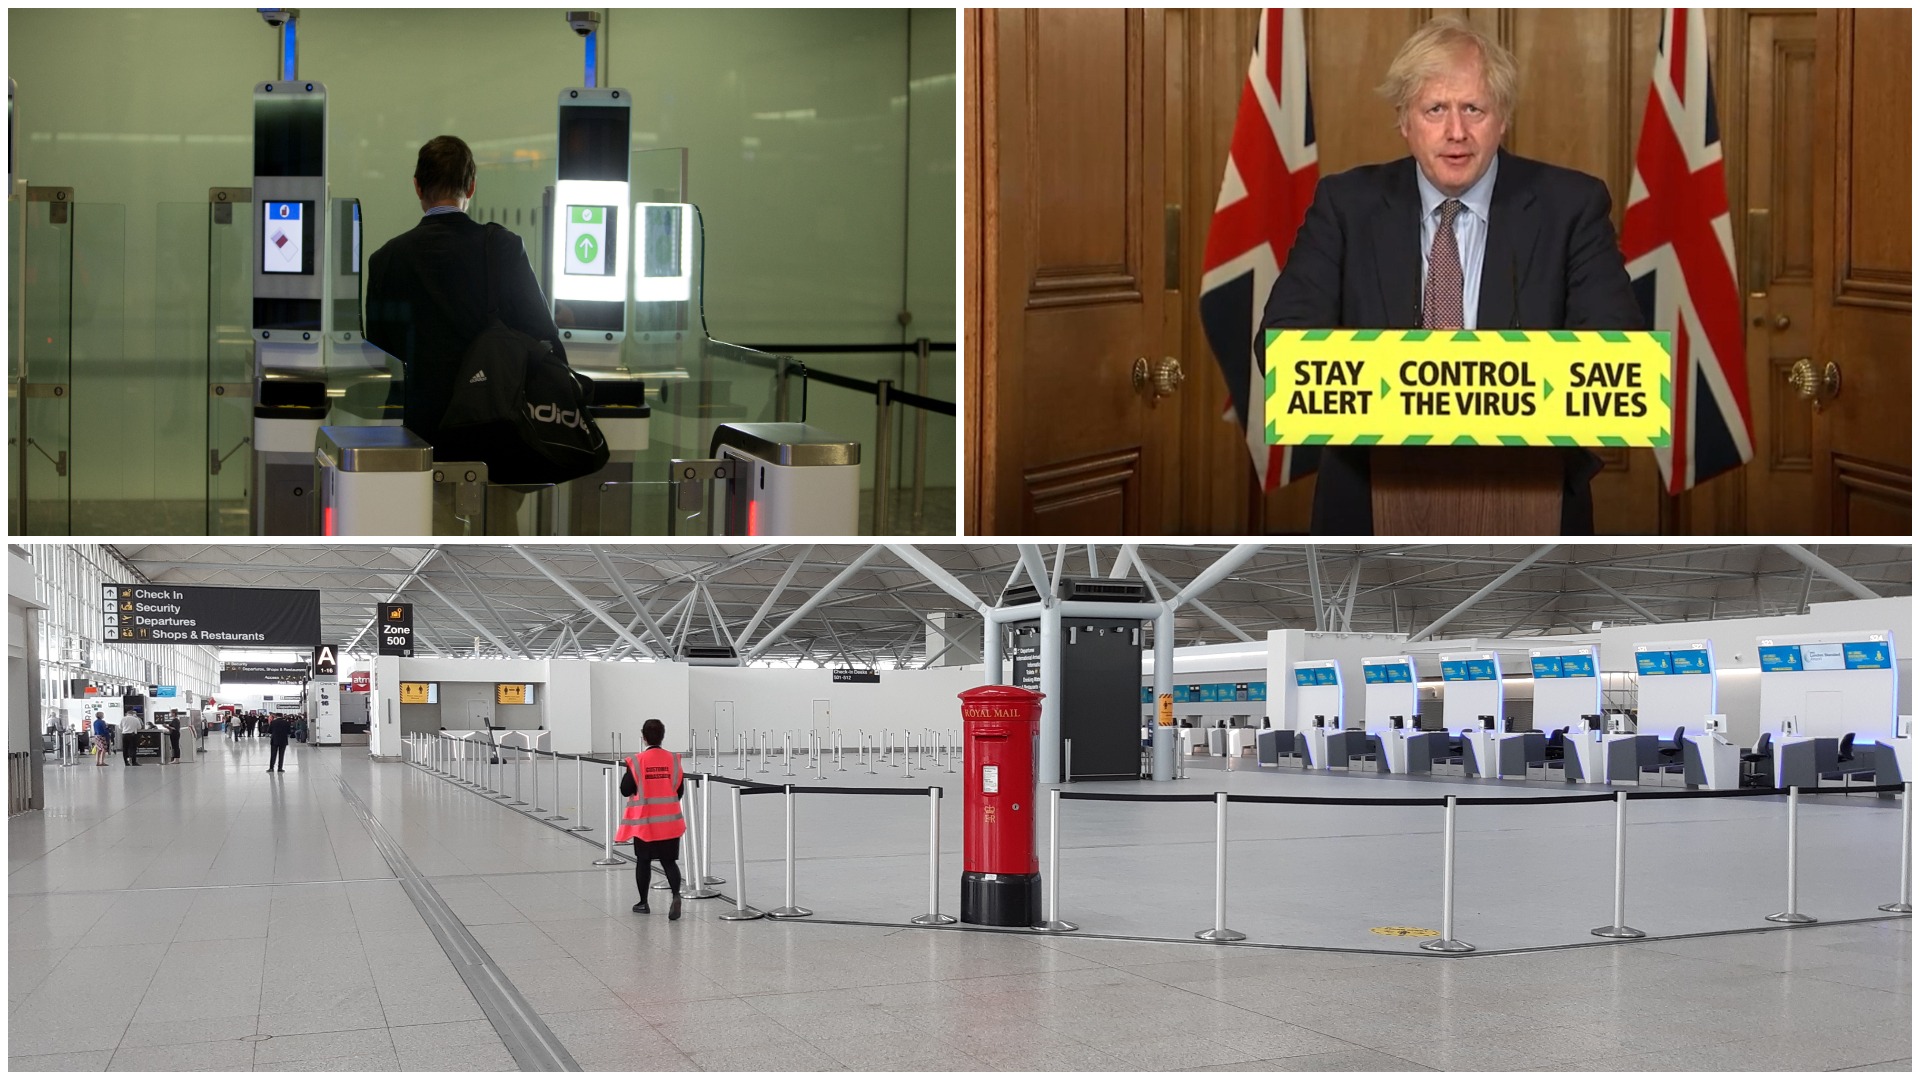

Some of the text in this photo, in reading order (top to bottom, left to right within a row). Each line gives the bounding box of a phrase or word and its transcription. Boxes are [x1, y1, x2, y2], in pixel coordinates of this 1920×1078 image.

[1295, 360, 1365, 386] STAY
[1400, 361, 1536, 387] CONTROL
[1570, 362, 1642, 388] SAVE
[1287, 390, 1373, 415] ALERT
[1400, 392, 1536, 417] THE VIRUS
[1566, 392, 1647, 418] LIVES
[135, 590, 183, 600] Check In
[136, 603, 181, 614] Security
[136, 616, 196, 627] Departures
[383, 625, 410, 634] Zone
[152, 630, 265, 641] Shops & Restaurants
[387, 637, 406, 645] 500
[318, 647, 336, 665] A
[353, 676, 370, 684] atm
[965, 709, 1020, 717] ROYAL MAIL
